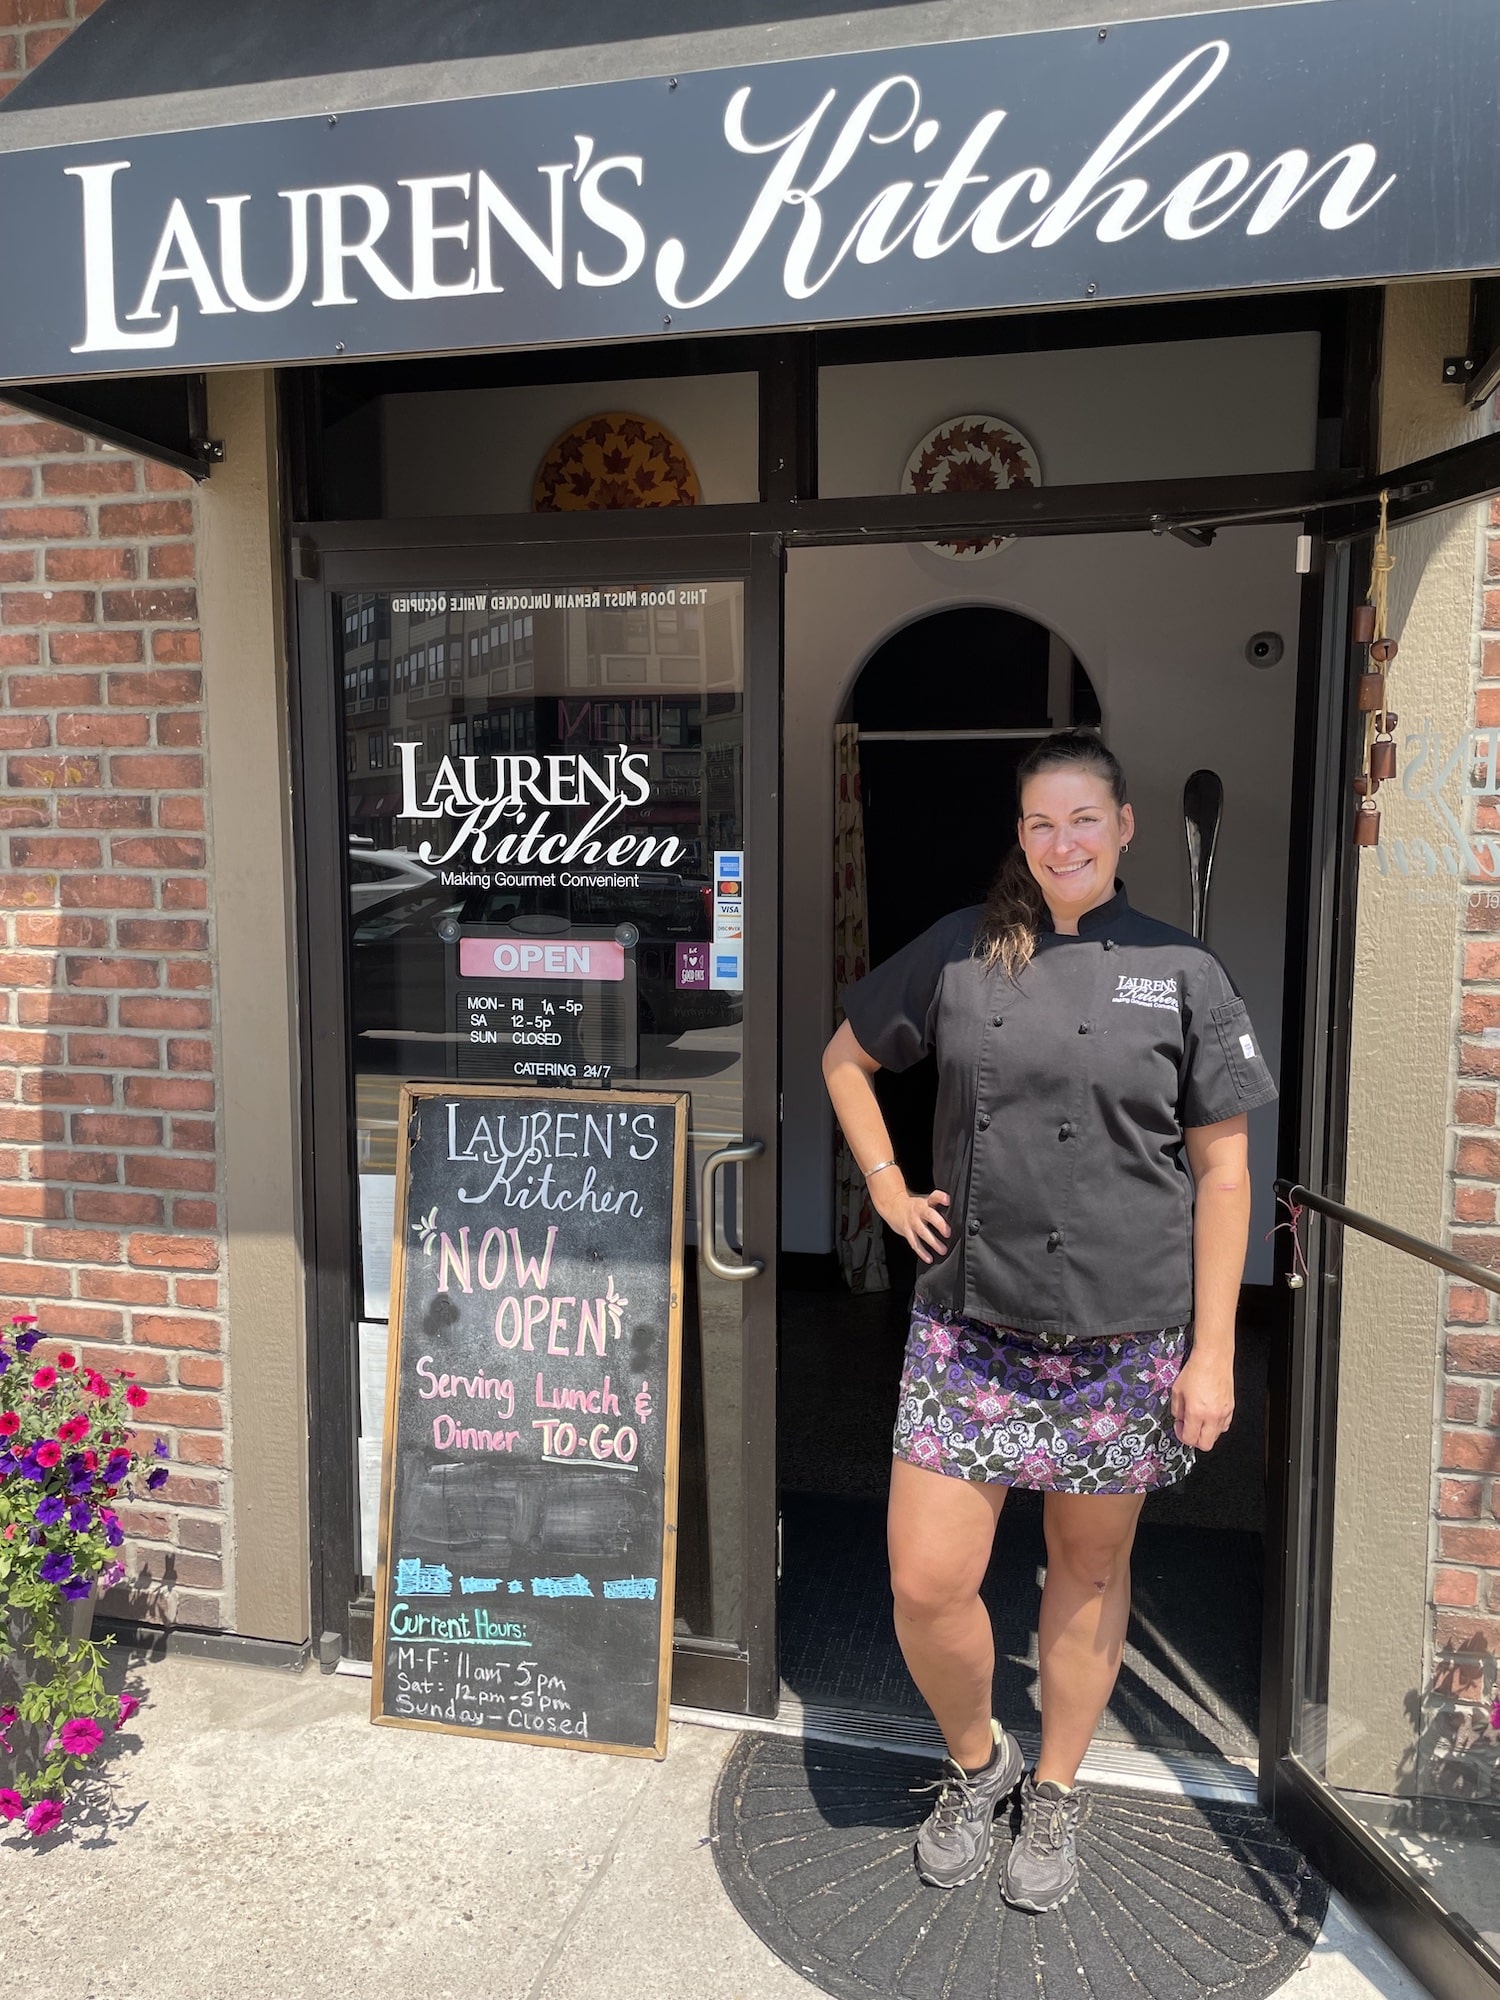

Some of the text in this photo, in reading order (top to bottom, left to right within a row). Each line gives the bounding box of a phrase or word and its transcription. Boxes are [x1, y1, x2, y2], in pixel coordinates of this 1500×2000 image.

[63, 40, 1397, 353] LAUREN'S Kitchen
[393, 742, 650, 819] LAUREN'S
[418, 790, 686, 867] Kitchen
[440, 871, 640, 889] Making Gourmet Convenient
[493, 944, 591, 973] OPEN
[470, 1014, 488, 1027] SA
[470, 1030, 562, 1046] SUN CLOSED
[514, 1062, 611, 1078] CATERING 24/7
[445, 1103, 658, 1161] LAUREN'S
[458, 1148, 643, 1218] Kitchen
[437, 1225, 559, 1293] NOW
[495, 1295, 607, 1357] OPEN
[416, 1355, 515, 1419] Serving
[536, 1372, 621, 1417] Lunch
[635, 1381, 652, 1424] &
[433, 1414, 638, 1463] Dinner TO-GO
[390, 1603, 527, 1639] Current Hours:
[397, 1672, 445, 1694] Sat:
[398, 1647, 449, 1673] M-F:
